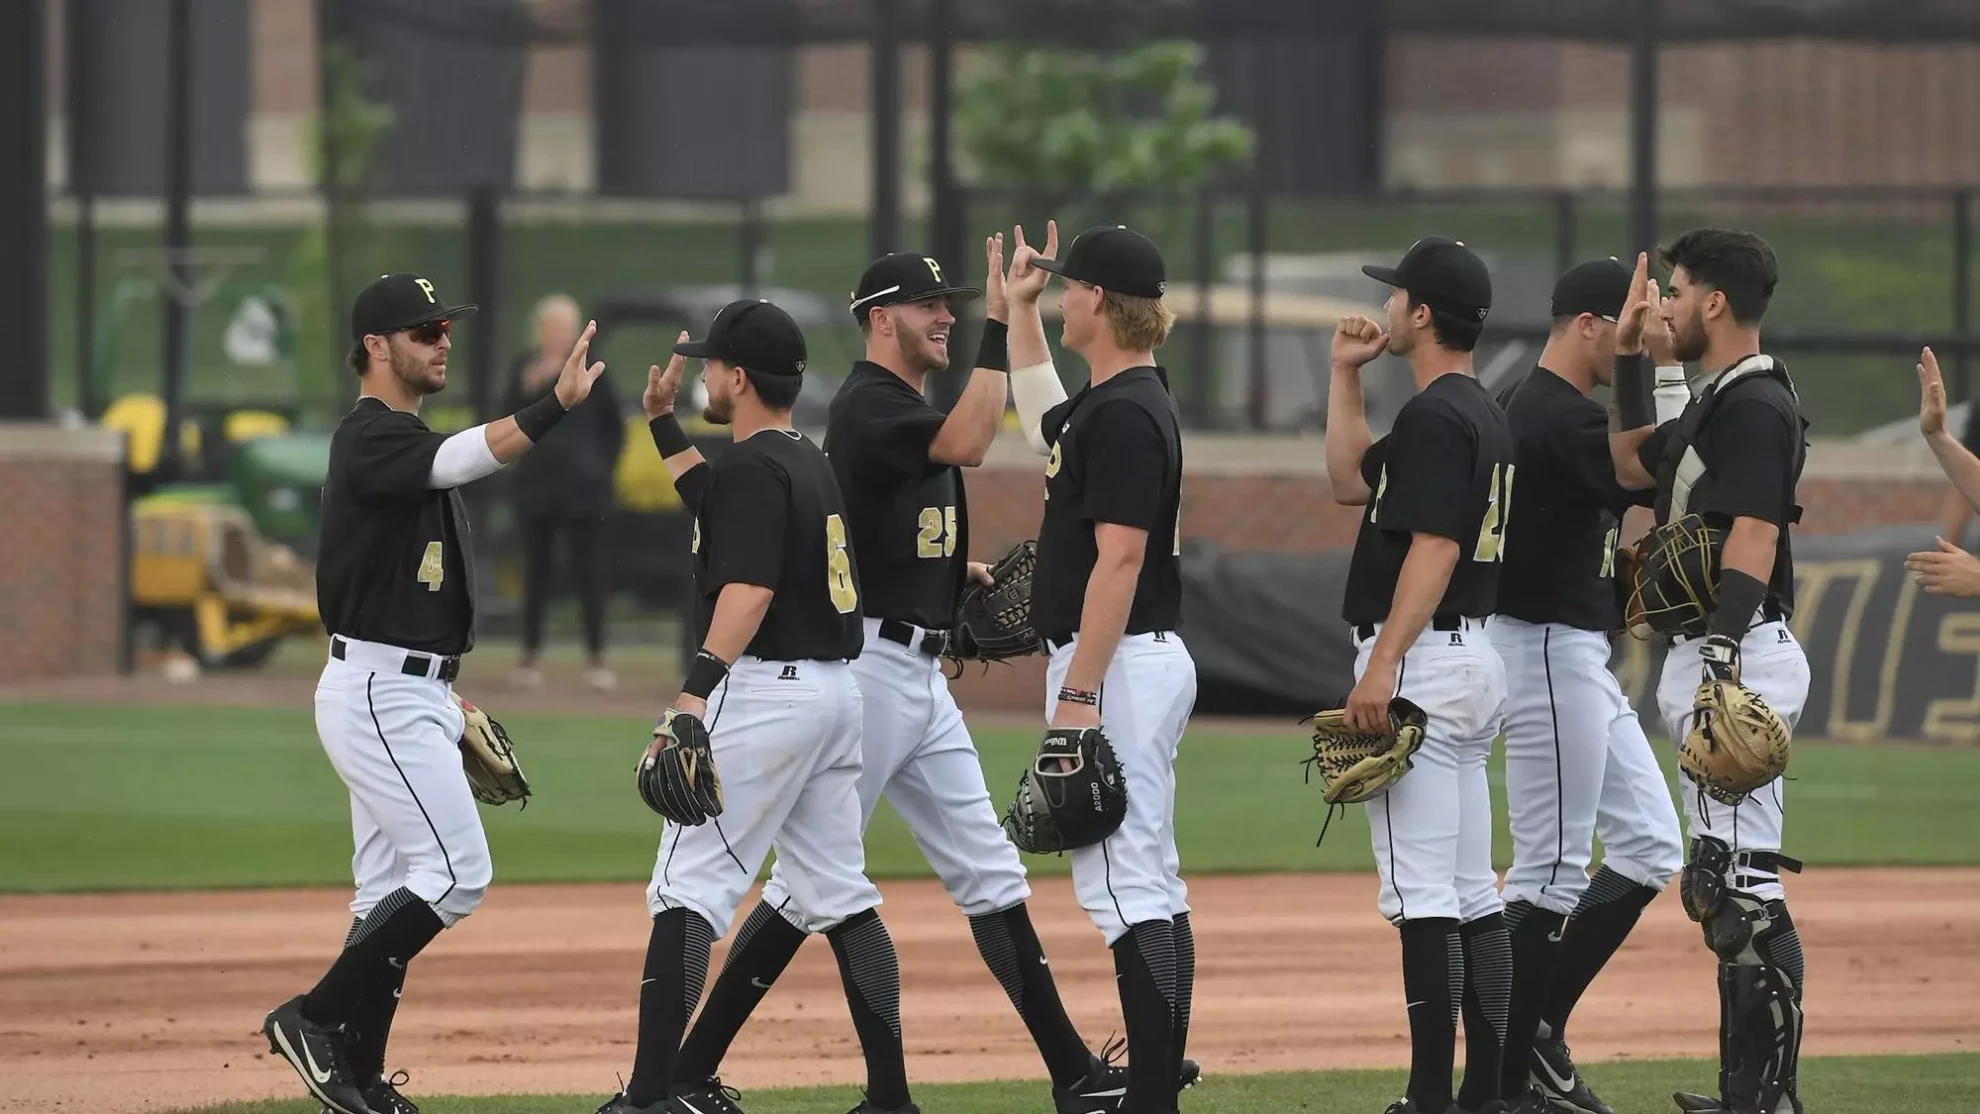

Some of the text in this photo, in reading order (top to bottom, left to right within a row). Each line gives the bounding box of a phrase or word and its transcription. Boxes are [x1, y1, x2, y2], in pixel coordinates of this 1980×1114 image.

[922, 257, 942, 283] P
[414, 278, 435, 304] P
[917, 506, 957, 558] 25
[417, 541, 444, 591] 4
[826, 513, 858, 614] 6
[781, 665, 797, 676] R
[1090, 781, 1103, 812] A2000
